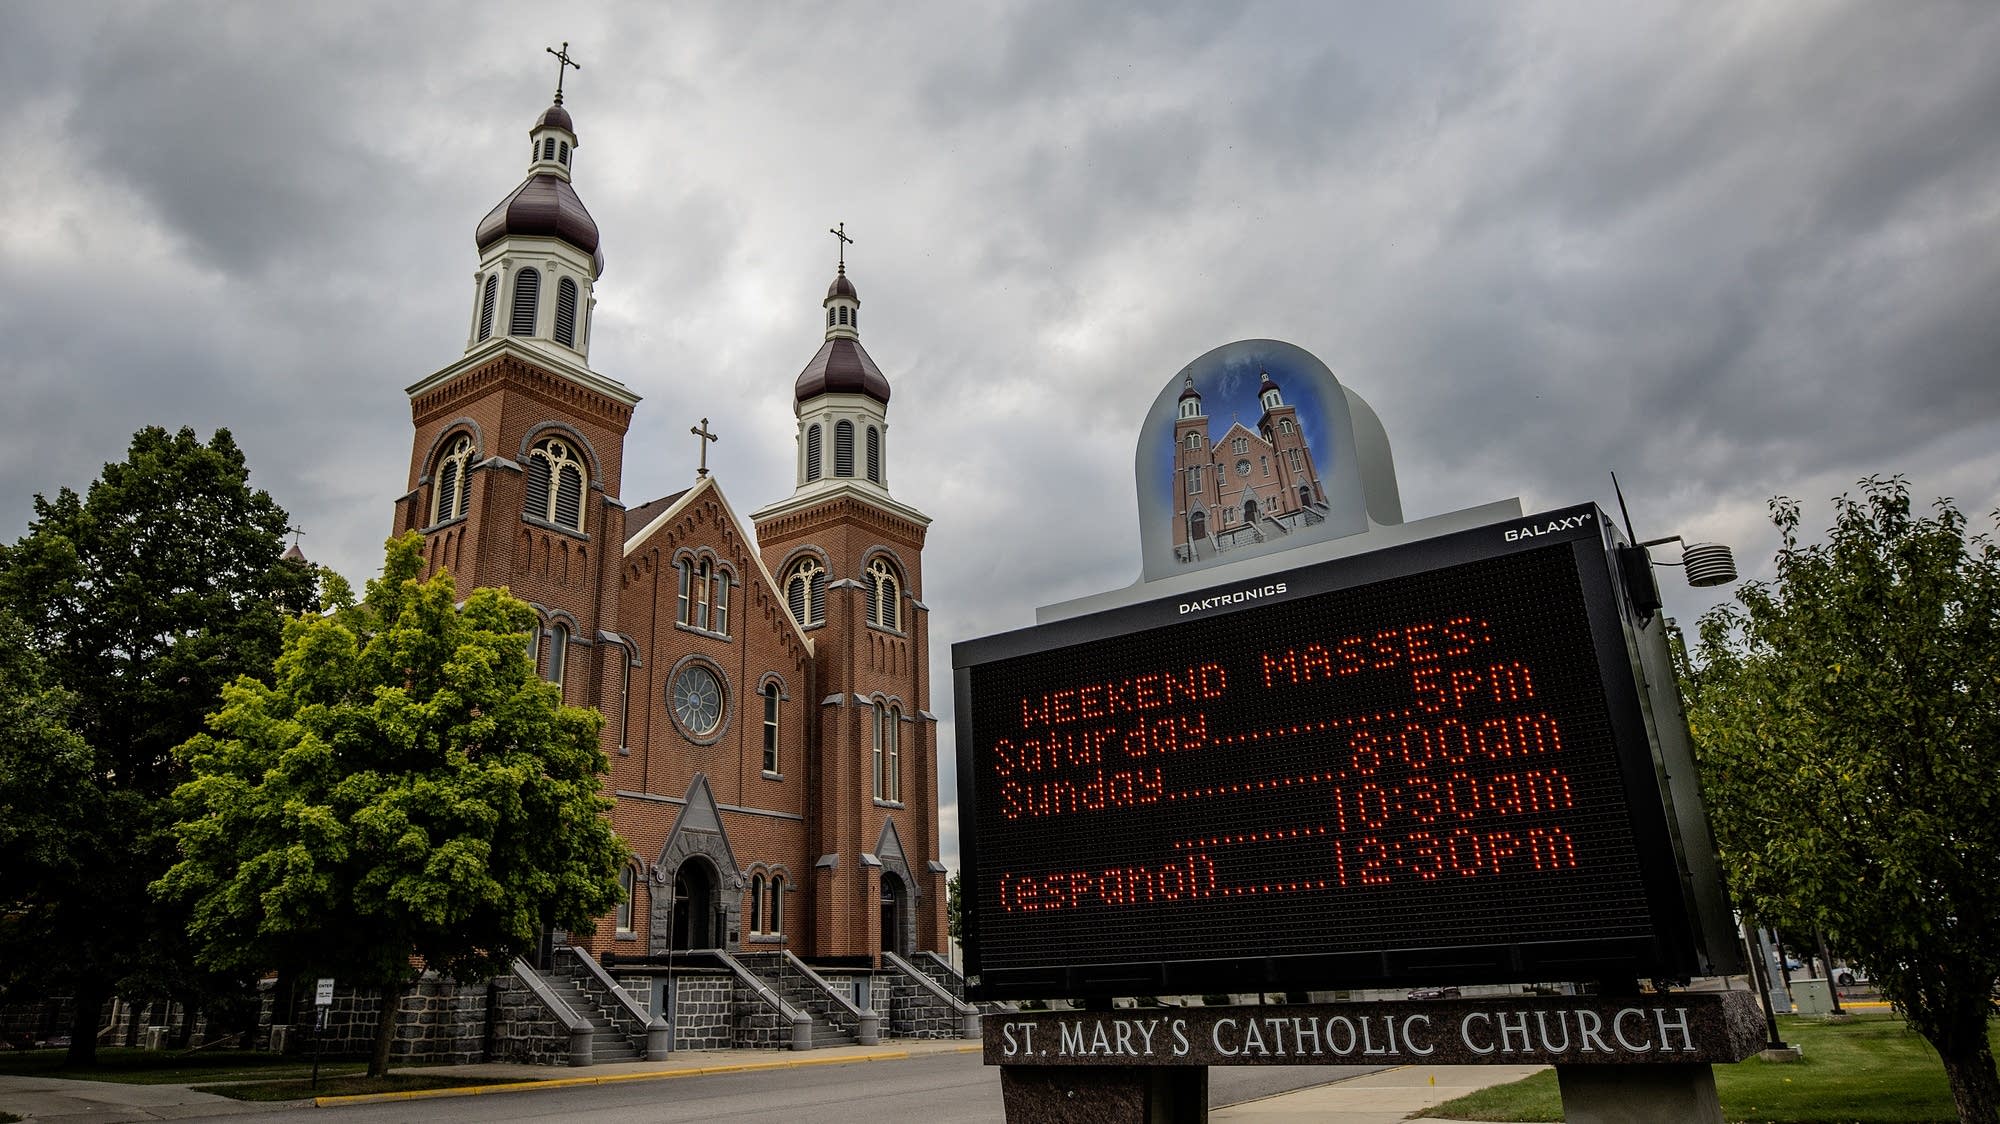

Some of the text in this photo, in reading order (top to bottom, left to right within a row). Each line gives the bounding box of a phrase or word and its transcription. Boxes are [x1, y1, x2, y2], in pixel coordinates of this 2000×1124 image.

[1179, 582, 1287, 615] DAKTRONICS
[1022, 616, 1491, 729] WEEKEND MASSES:
[1002, 1007, 1697, 1058] ST. MARY'S CATHOLIC CHURCH
